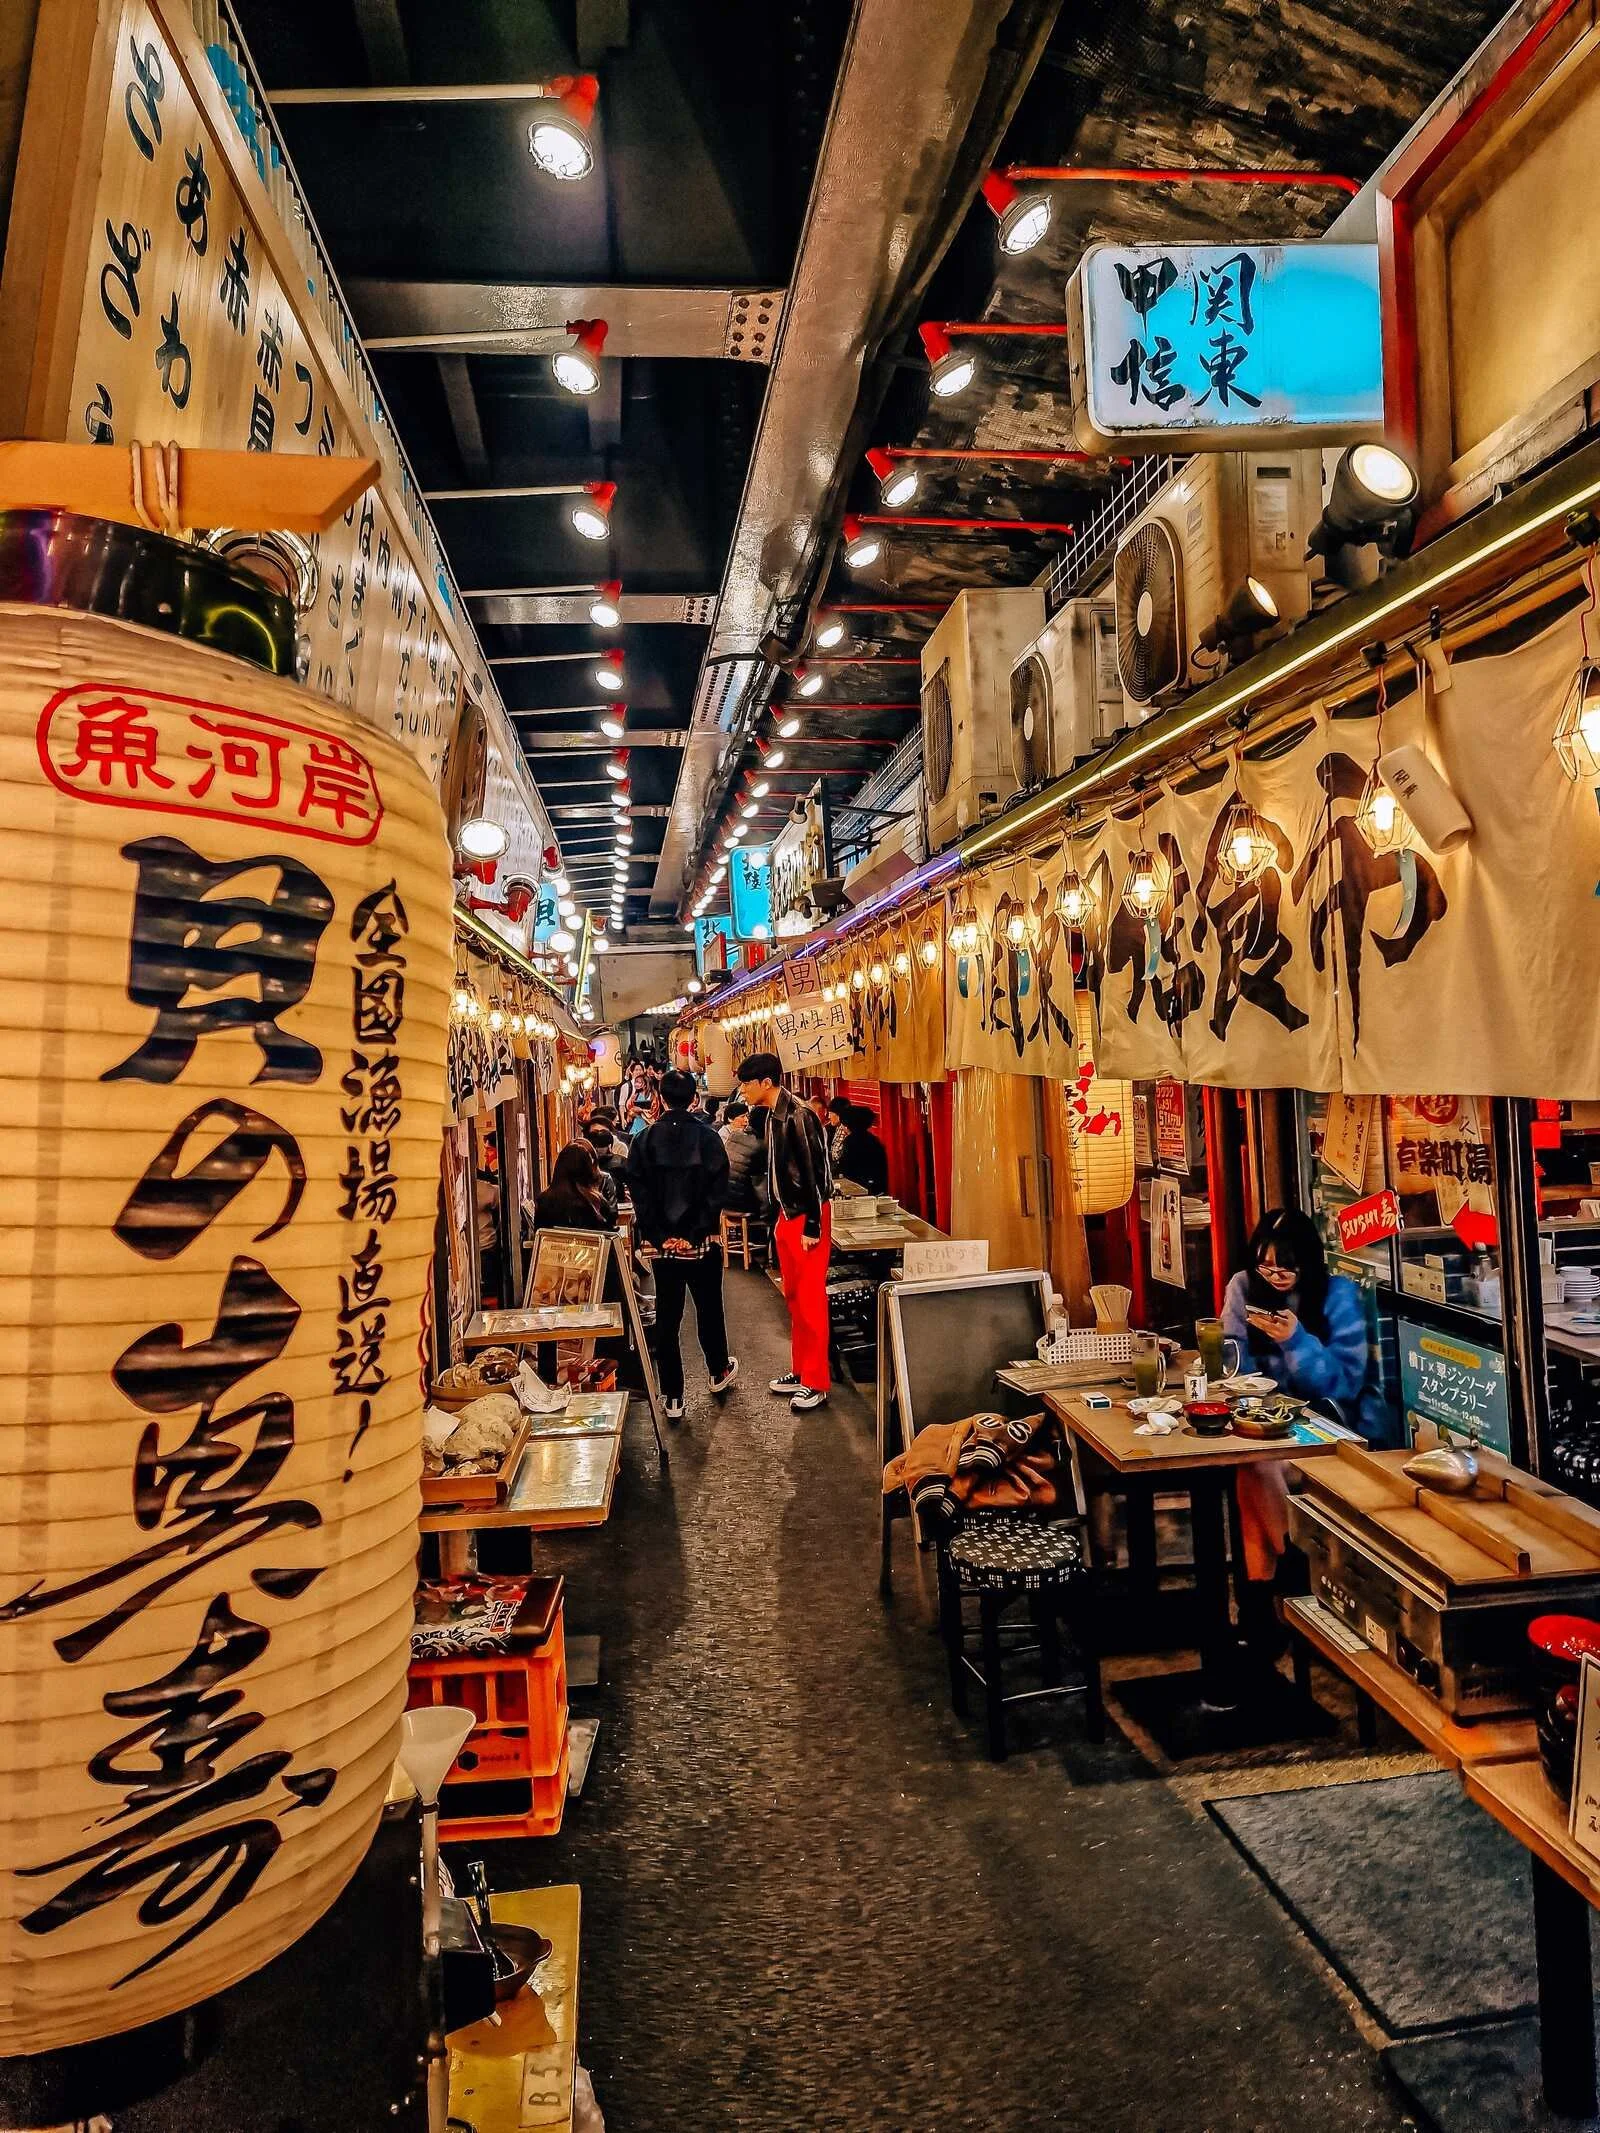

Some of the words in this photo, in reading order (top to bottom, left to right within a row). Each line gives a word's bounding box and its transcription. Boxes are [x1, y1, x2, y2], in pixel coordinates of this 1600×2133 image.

[1110, 256, 1186, 412] 甲信
[1189, 252, 1263, 409] 関東
[61, 697, 371, 829] 魚河岸
[789, 962, 815, 996] 男
[1341, 1208, 1380, 1240] SUSHI
[1420, 1375, 1488, 1411] スタンプラリー
